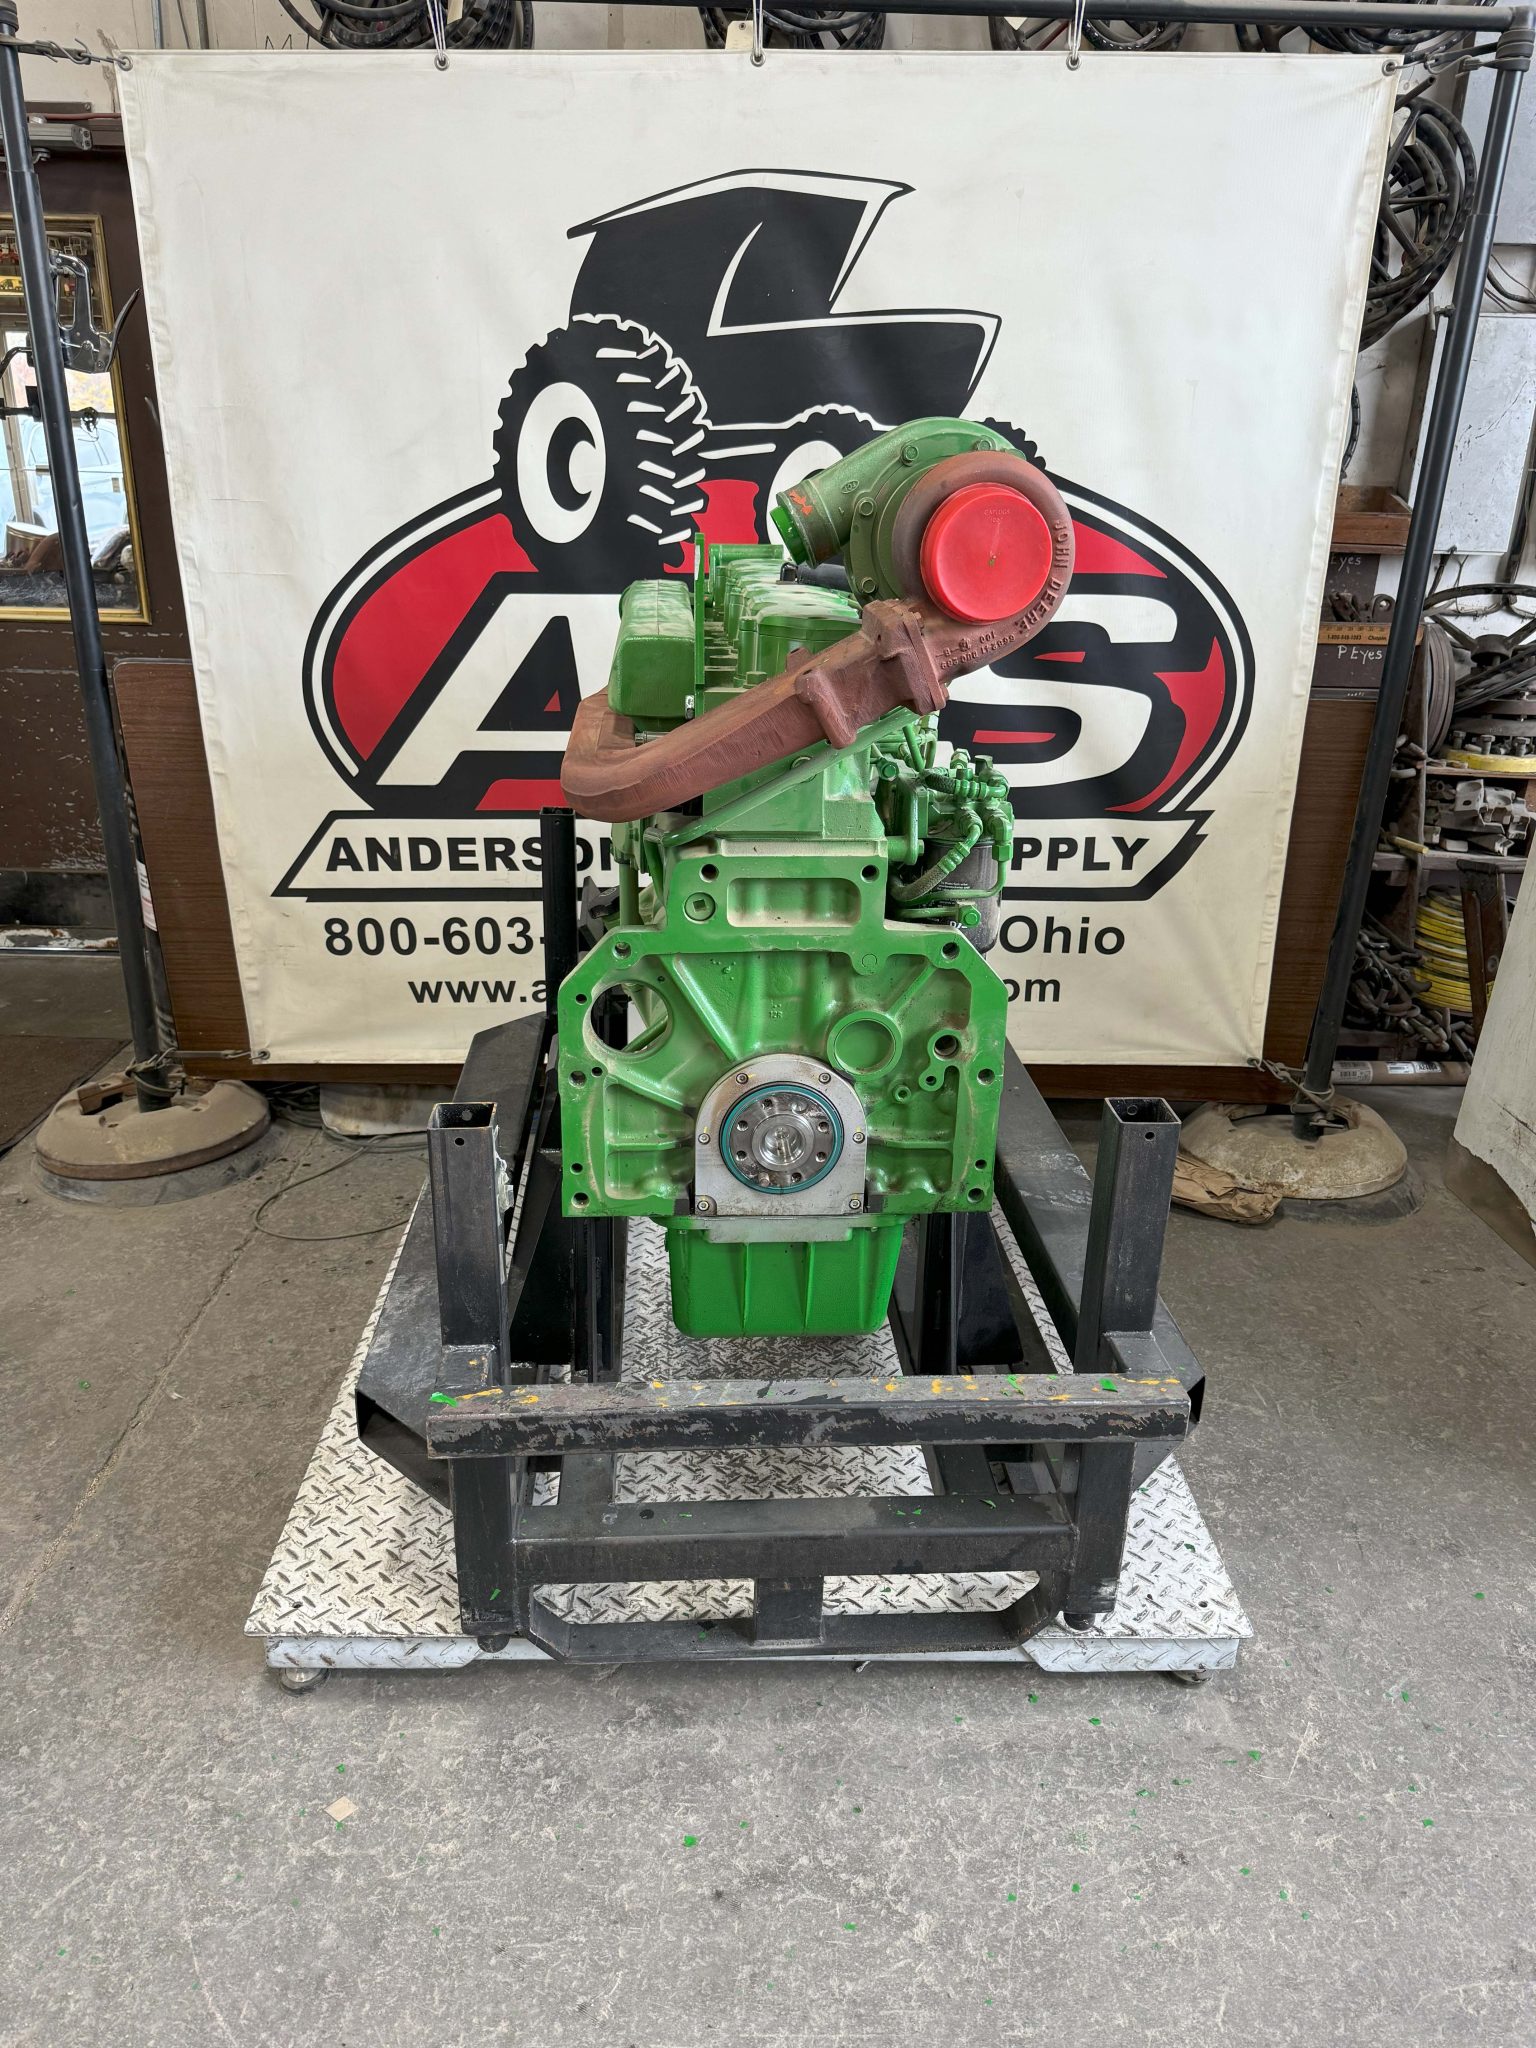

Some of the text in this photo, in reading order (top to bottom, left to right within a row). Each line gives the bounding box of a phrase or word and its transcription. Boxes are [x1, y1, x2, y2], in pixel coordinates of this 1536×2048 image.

[1015, 520, 1071, 635] JOHN DEERE
[1337, 645, 1384, 665] P Eyes
[324, 915, 1126, 956] 800-603 Ohio
[408, 980, 547, 1003] www.a
